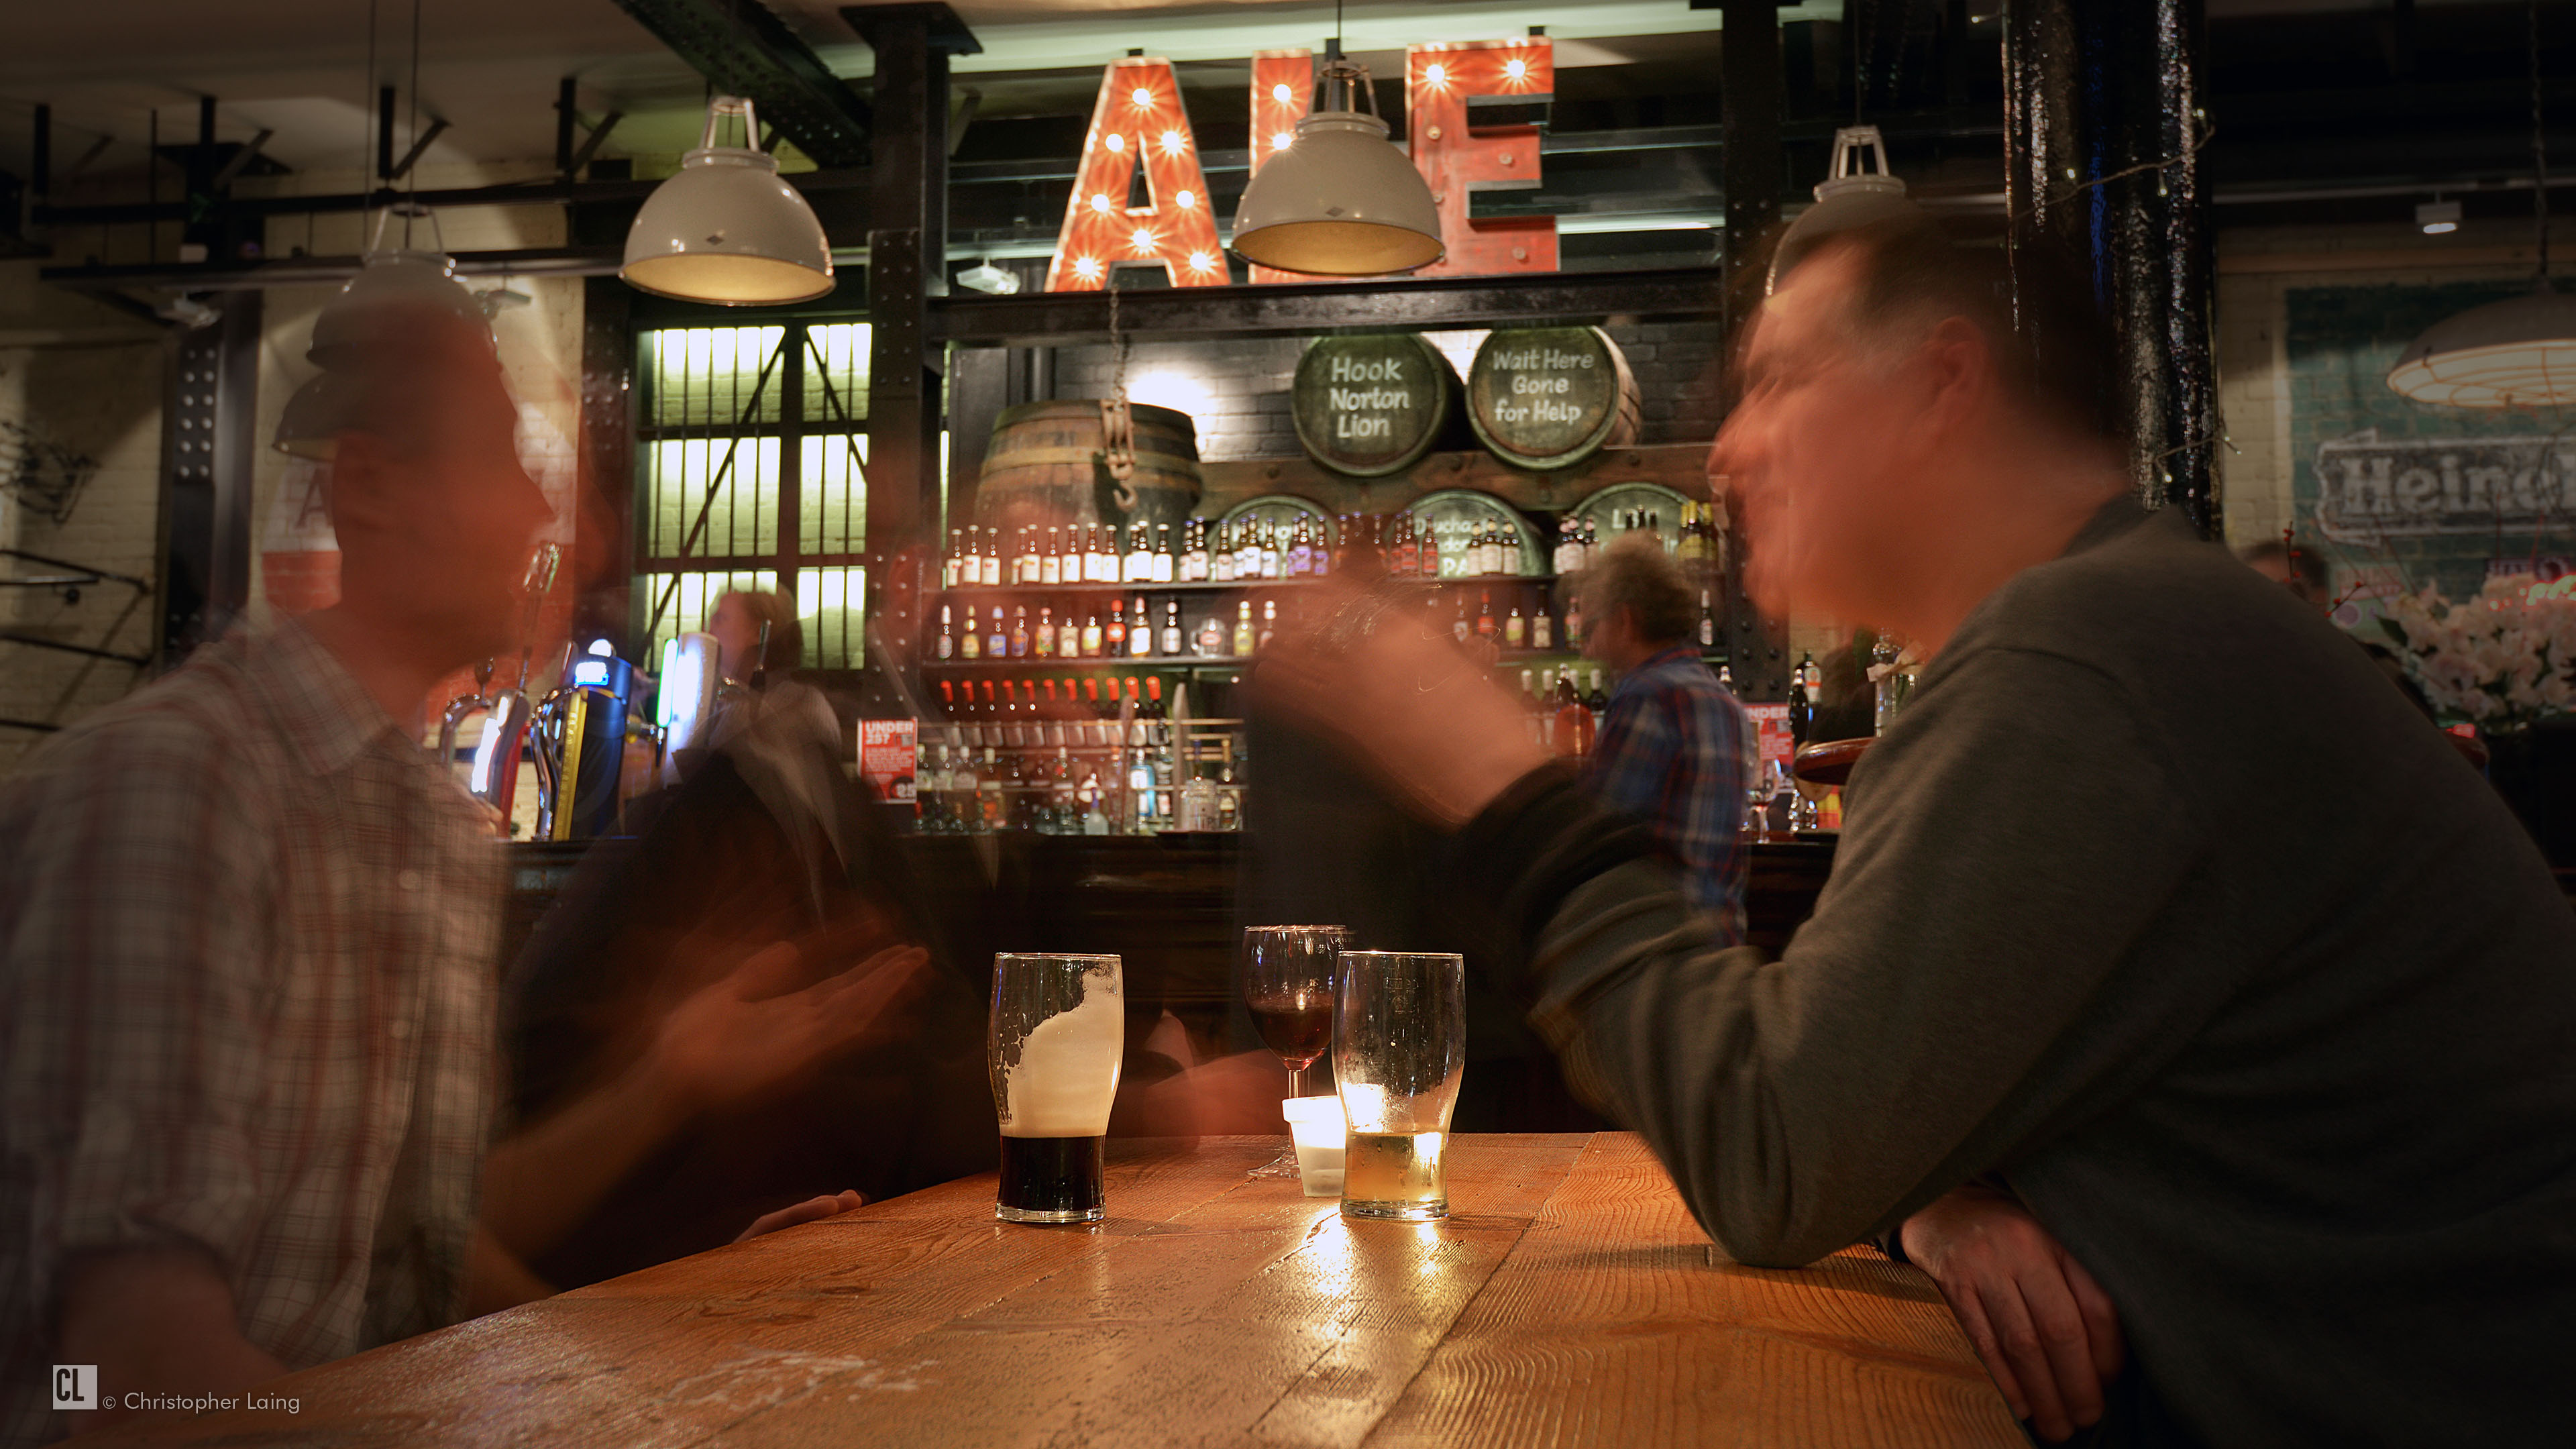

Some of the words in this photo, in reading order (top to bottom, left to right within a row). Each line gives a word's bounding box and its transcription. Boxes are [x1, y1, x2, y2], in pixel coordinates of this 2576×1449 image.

[1331, 356, 1402, 382] Hook
[1493, 348, 1540, 370] Wait
[1544, 348, 1595, 369] Here
[1512, 375, 1569, 394] Gone
[1330, 386, 1410, 411] Norton
[1495, 398, 1529, 422] for
[1534, 400, 1581, 425] Help
[1337, 414, 1390, 438] Lion
[1745, 707, 1789, 718] NDER
[865, 721, 914, 733] UNDER
